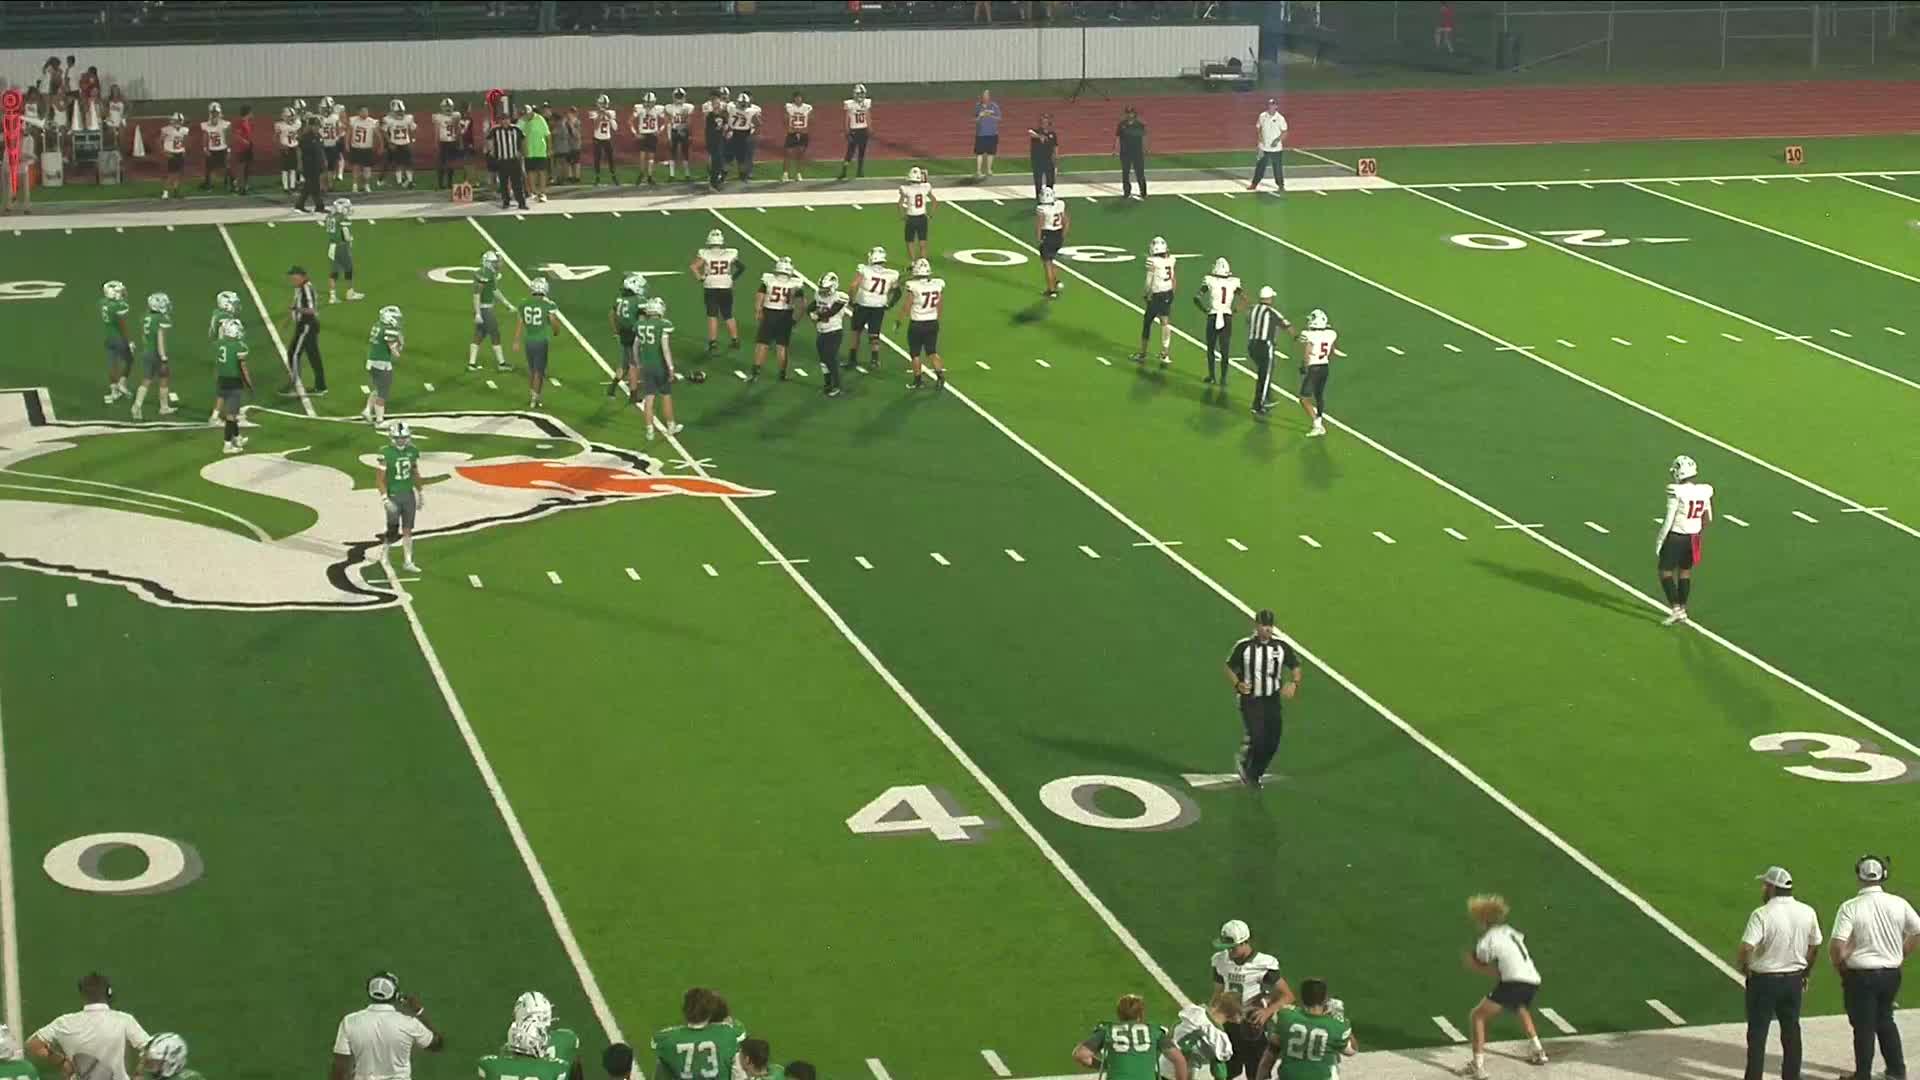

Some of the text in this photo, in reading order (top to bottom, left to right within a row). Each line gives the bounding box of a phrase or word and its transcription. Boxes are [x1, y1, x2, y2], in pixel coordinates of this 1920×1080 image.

[731, 114, 746, 128] 73
[1788, 148, 1801, 161] 10
[1360, 159, 1376, 174] 20
[454, 184, 472, 200] 40
[710, 260, 729, 276] 52
[1164, 266, 1172, 282] 3
[770, 286, 792, 304] 54
[869, 276, 886, 296] 71
[1220, 286, 1227, 305] 1
[921, 290, 940, 309] 72
[523, 306, 543, 326] 62
[637, 325, 656, 345] 55
[218, 345, 228, 364] 3
[1318, 342, 1329, 360] 5
[394, 460, 411, 481] 12
[1687, 500, 1705, 520] 12
[1110, 1023, 1152, 1053] 50
[1287, 1023, 1330, 1062] 20
[675, 1040, 720, 1079] 73
